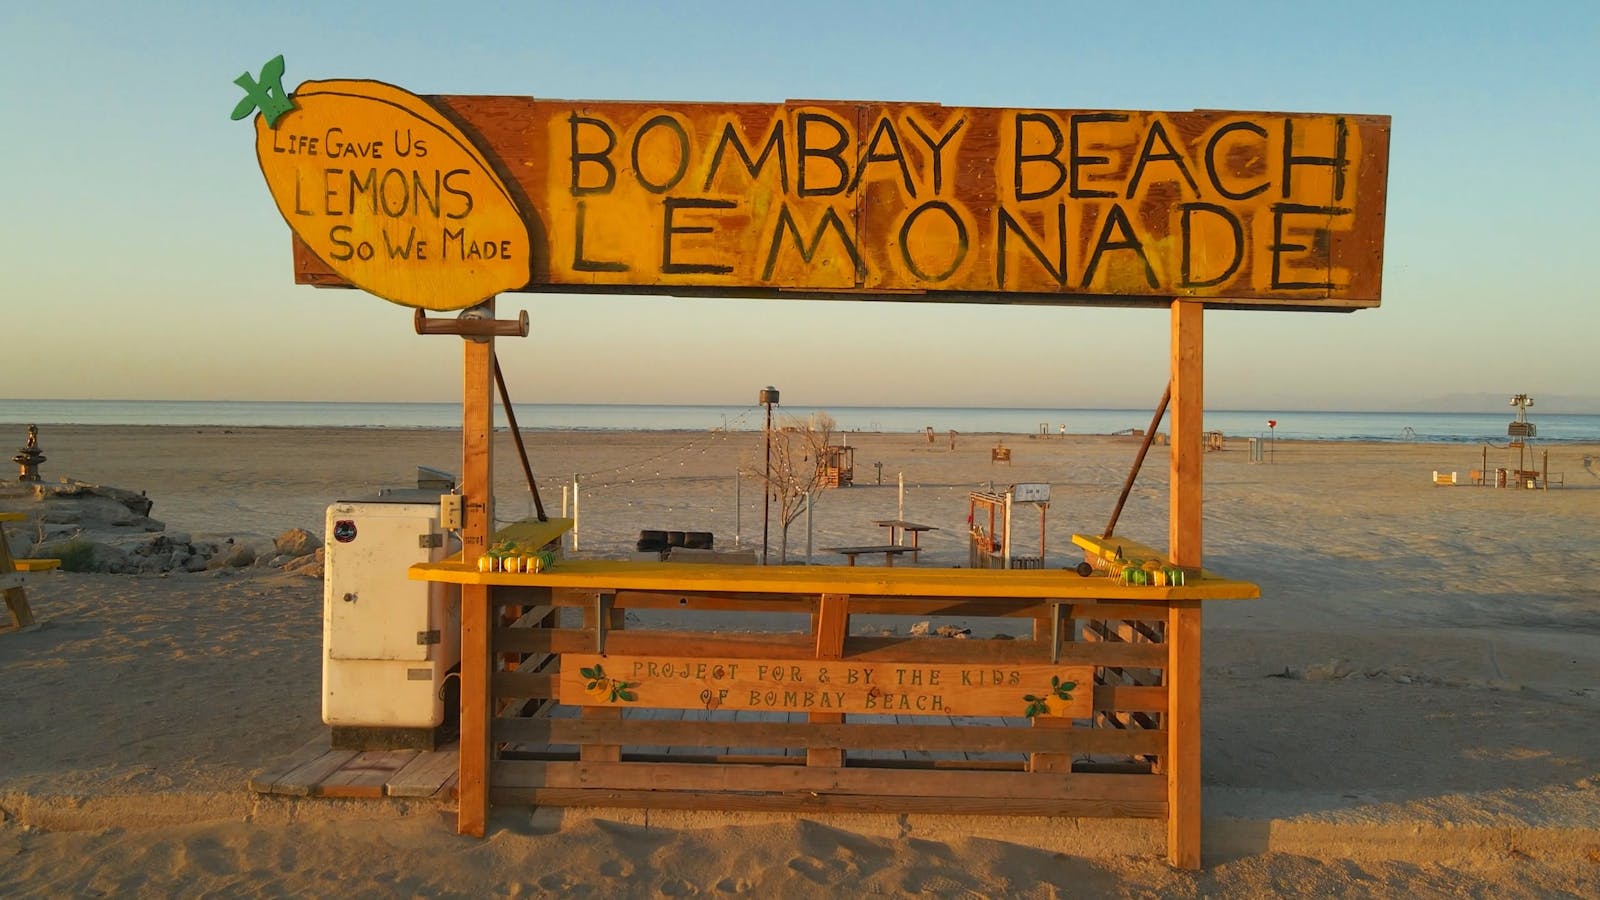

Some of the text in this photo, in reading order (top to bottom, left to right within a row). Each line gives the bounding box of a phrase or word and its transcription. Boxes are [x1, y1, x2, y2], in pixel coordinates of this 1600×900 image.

[273, 125, 428, 159] LIFE GAVE US
[568, 110, 1352, 202] BOMBAY BEACH
[295, 168, 474, 220] LEMONS
[329, 225, 512, 262] SO WE MADE
[572, 195, 1352, 291] LEMONADE
[633, 661, 1021, 686] PROJECT FOR & BY THE KIDS
[700, 689, 729, 706] OF
[750, 690, 846, 709] BOMBAY
